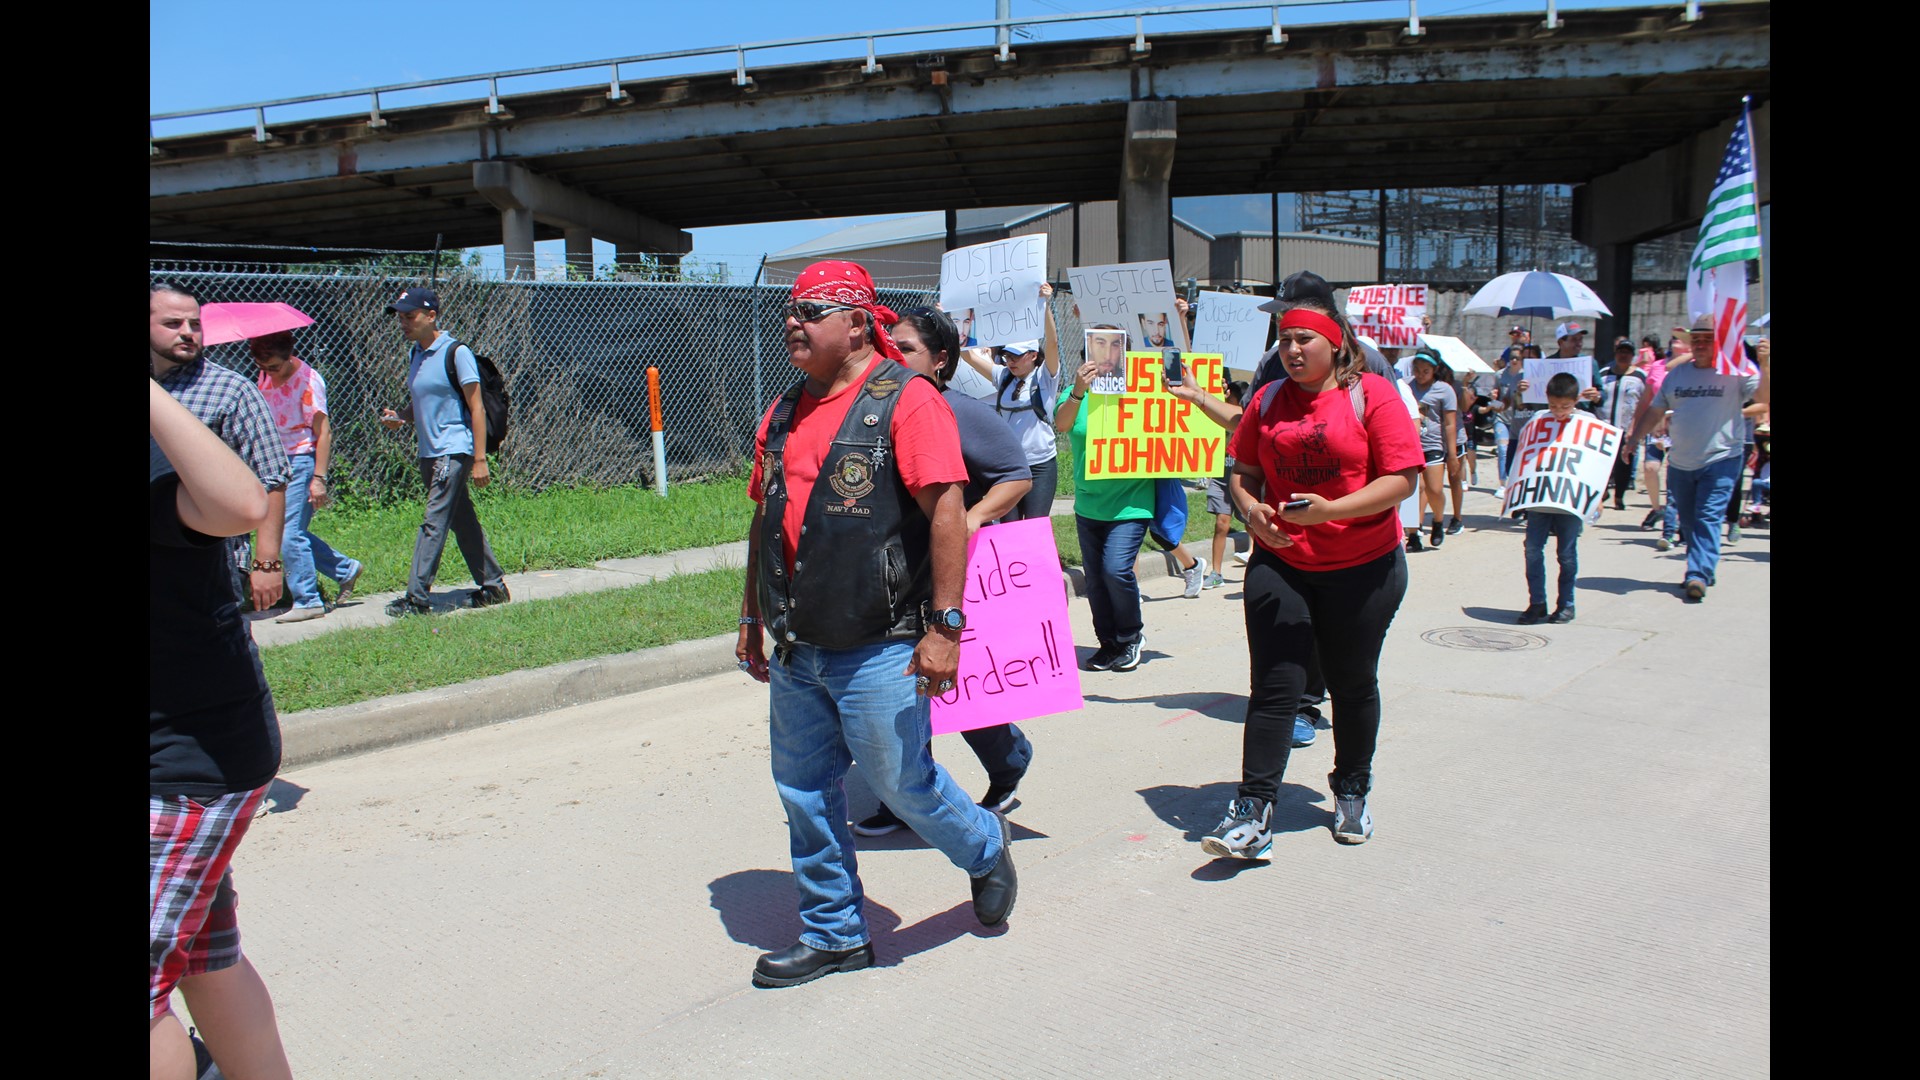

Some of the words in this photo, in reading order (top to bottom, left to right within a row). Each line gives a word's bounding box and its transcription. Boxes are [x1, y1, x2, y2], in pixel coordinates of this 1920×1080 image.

[941, 238, 1039, 286] JUSTICE
[977, 277, 1016, 304] FOR
[1070, 268, 1168, 299] JUSTICE
[1348, 287, 1425, 306] #JUSTICE
[1099, 295, 1129, 315] FOR
[1363, 306, 1406, 325] FOR
[983, 305, 1040, 341] JOHN
[1126, 357, 1222, 394] USCE
[1117, 398, 1192, 433] FOR
[1089, 437, 1221, 474] JOHNNY
[1519, 446, 1583, 476] FOR
[827, 505, 848, 513] NAVY
[852, 507, 870, 515] DAD
[931, 620, 1064, 708] urder!!
